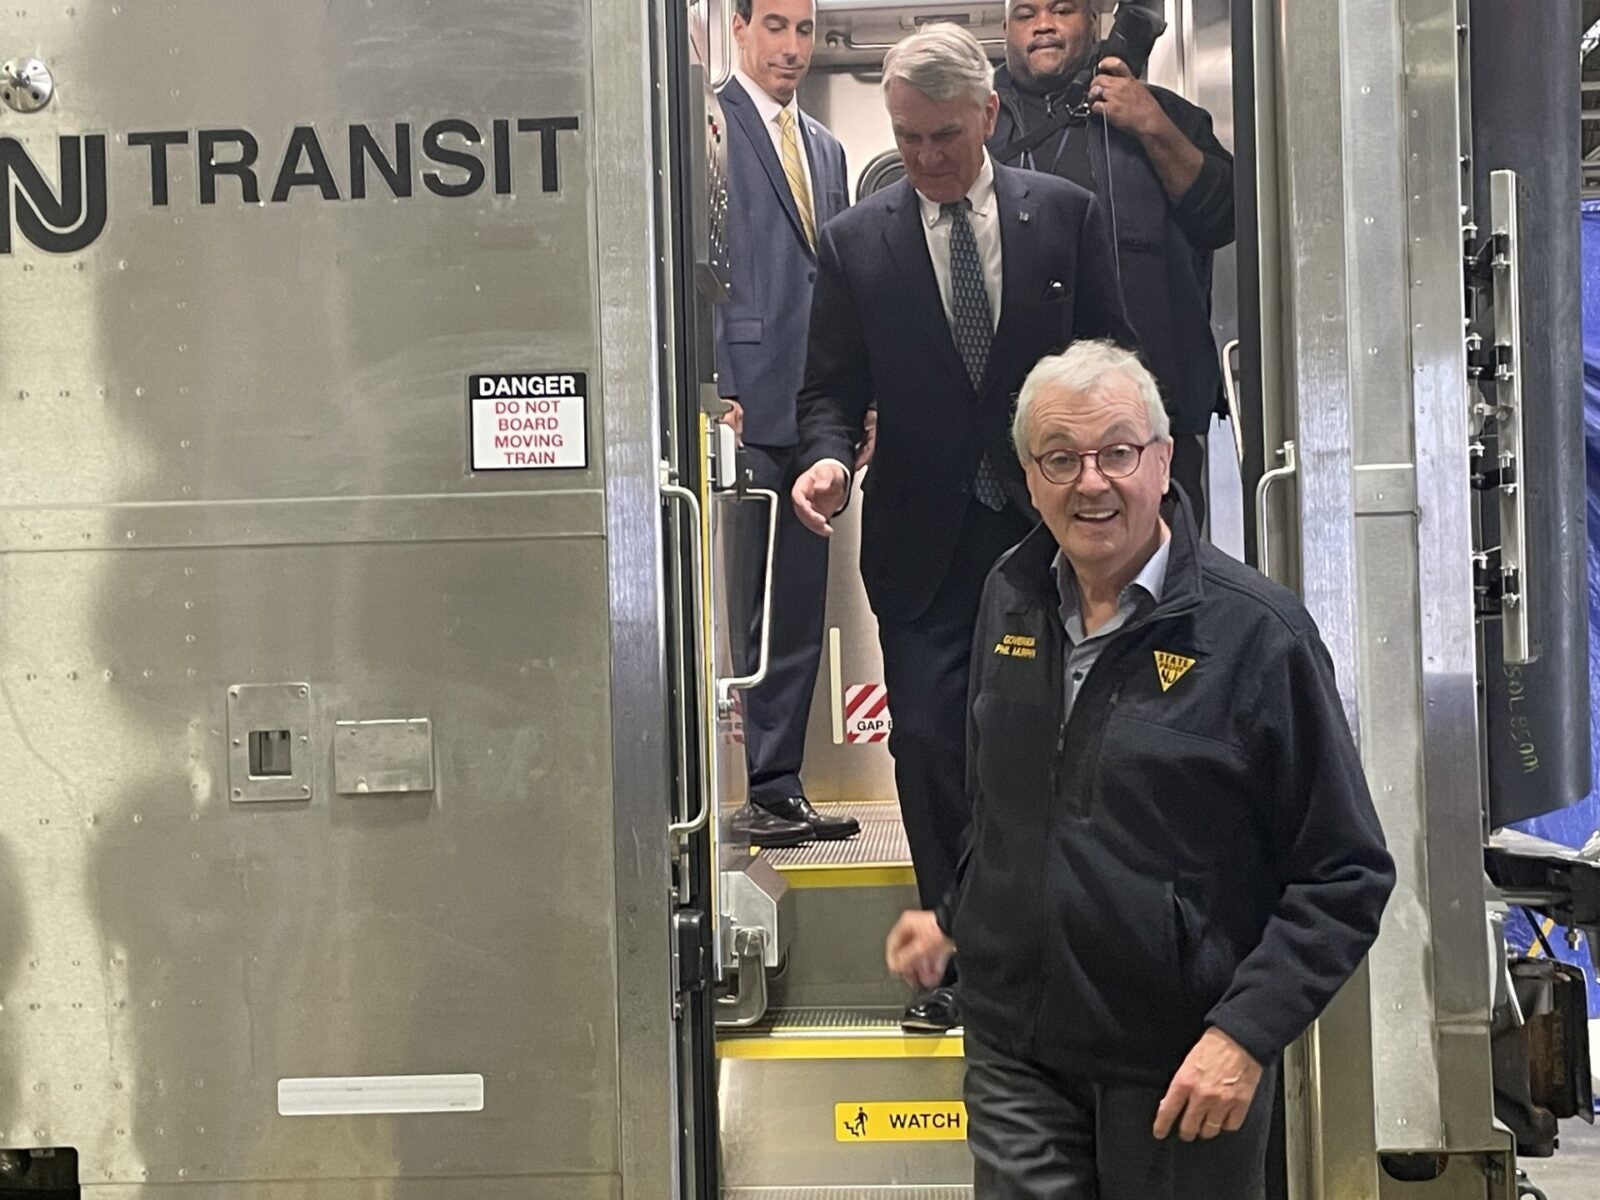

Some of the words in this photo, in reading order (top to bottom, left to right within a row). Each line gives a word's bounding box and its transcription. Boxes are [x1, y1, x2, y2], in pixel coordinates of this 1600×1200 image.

[127, 116, 579, 206] TRANSIT
[479, 375, 576, 396] DANGER
[495, 401, 520, 414] DO
[525, 400, 561, 414] NOT
[498, 417, 559, 431] BOARD
[495, 434, 564, 448] MOVING
[504, 451, 555, 465] TRAIN
[1158, 653, 1189, 668] STATE
[857, 720, 884, 731] GAP
[889, 1113, 960, 1129] WATCH
